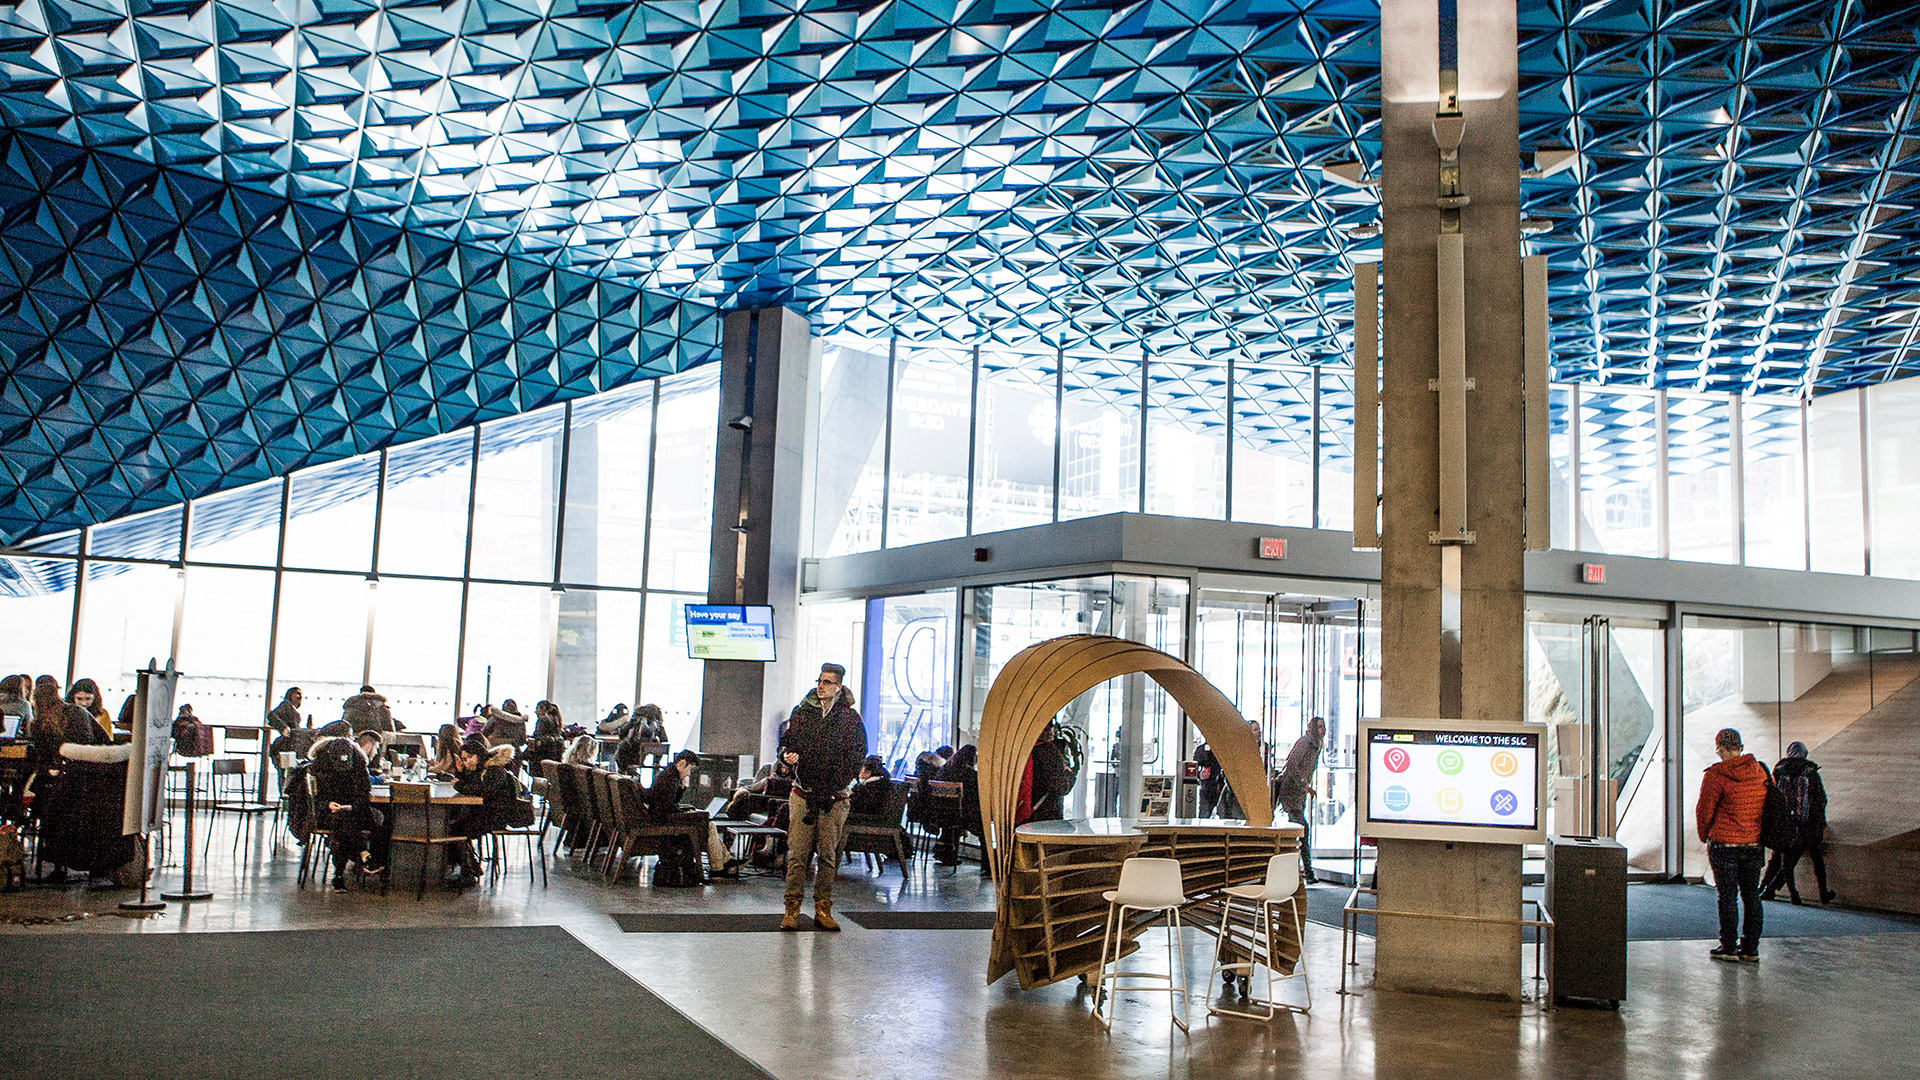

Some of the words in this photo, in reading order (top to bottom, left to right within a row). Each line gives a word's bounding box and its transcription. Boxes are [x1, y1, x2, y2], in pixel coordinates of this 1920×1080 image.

[894, 394, 970, 417] UESDAYS
[1264, 540, 1284, 557] EXIT
[1587, 565, 1604, 582] EXIT
[690, 610, 709, 619] Have
[709, 612, 727, 620] your
[727, 613, 741, 621] say
[1435, 734, 1478, 745] WELCOME
[1479, 735, 1492, 745] TO
[1493, 736, 1510, 746] THE
[1511, 737, 1527, 746] SLC
